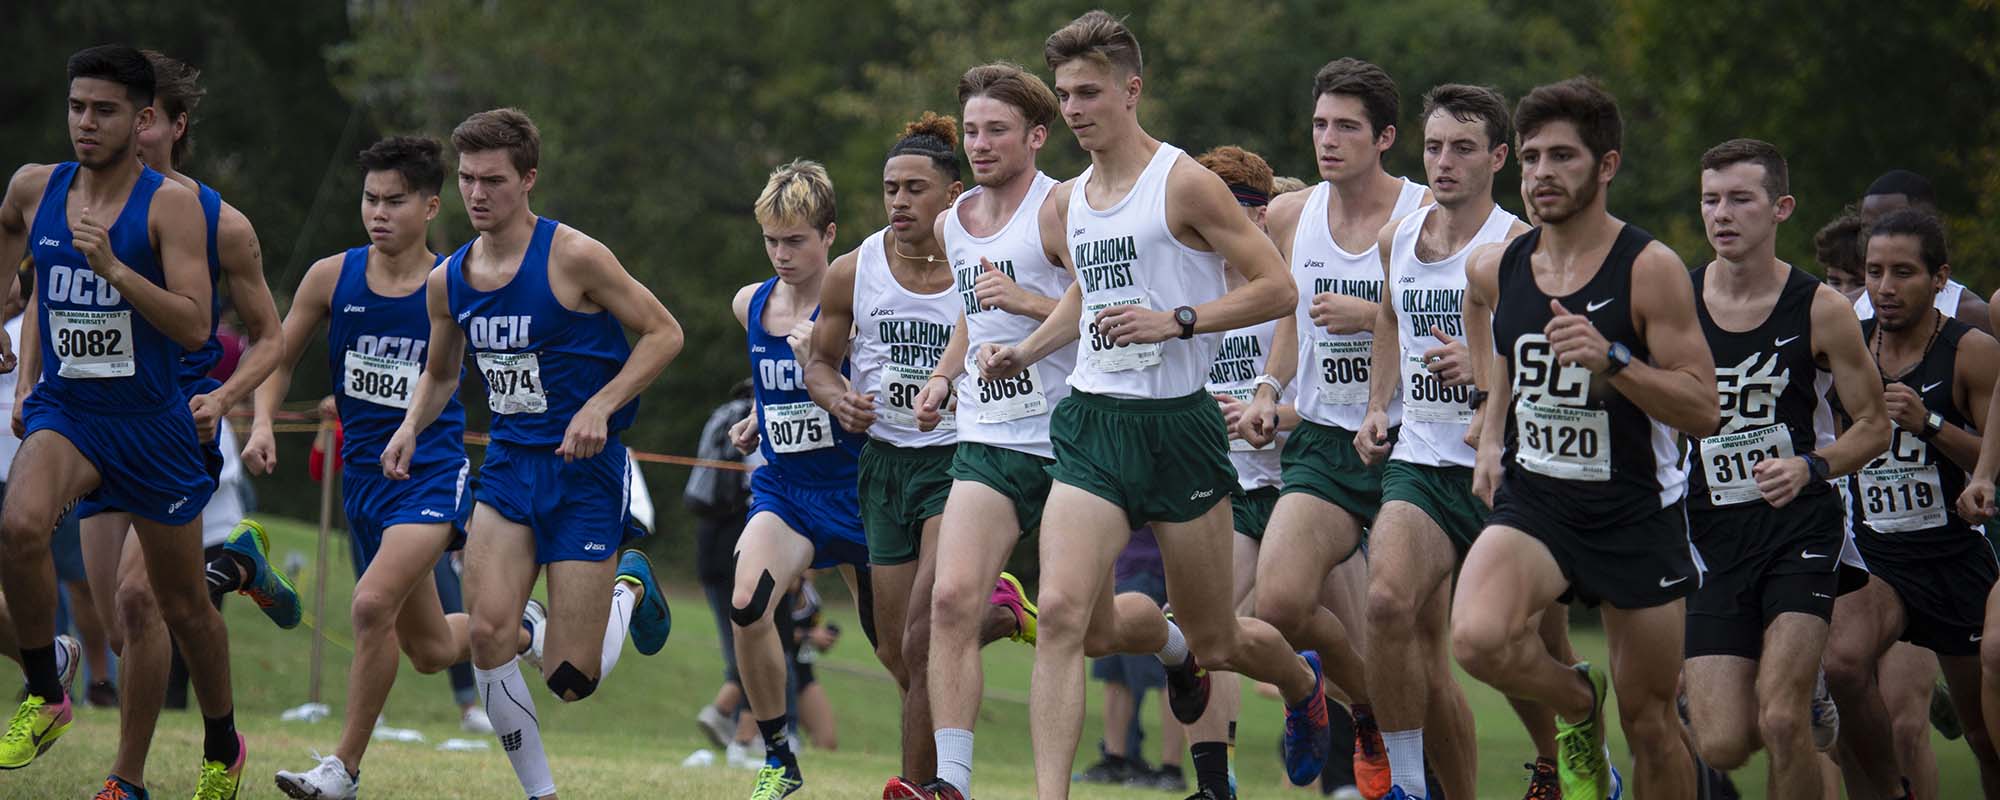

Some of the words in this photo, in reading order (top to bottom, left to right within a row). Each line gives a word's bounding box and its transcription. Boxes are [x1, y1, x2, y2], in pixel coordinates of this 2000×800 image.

[1076, 236, 1138, 269] OKLAHOMA
[48, 265, 121, 306] OCU
[1082, 262, 1134, 293] BAPTIST
[470, 316, 532, 350] OCU
[880, 321, 956, 346] OKLAHOM
[1411, 314, 1463, 337] BAPTIST
[58, 328, 123, 358] 3082
[891, 344, 946, 368] BAPTIS
[1214, 336, 1262, 362] AHOMA
[352, 352, 384, 364] OKLAHOMA
[888, 365, 924, 375] OKLAHOMA
[1322, 357, 1372, 384] 306
[352, 368, 408, 400] 3084
[978, 366, 1034, 403] 3068
[1209, 360, 1256, 384] BAPTIST
[1522, 402, 1562, 414] OKLAHOMA
[1564, 409, 1597, 418] BAPTIST
[1534, 412, 1580, 422] UNIVERSITY
[772, 418, 822, 445] 3075
[1526, 421, 1598, 458] 3120
[1707, 434, 1746, 444] OKLAHOMA
[1748, 427, 1779, 439] BAPTIST
[1722, 437, 1765, 448] UNIVERSITY
[1867, 482, 1934, 513] 3119
